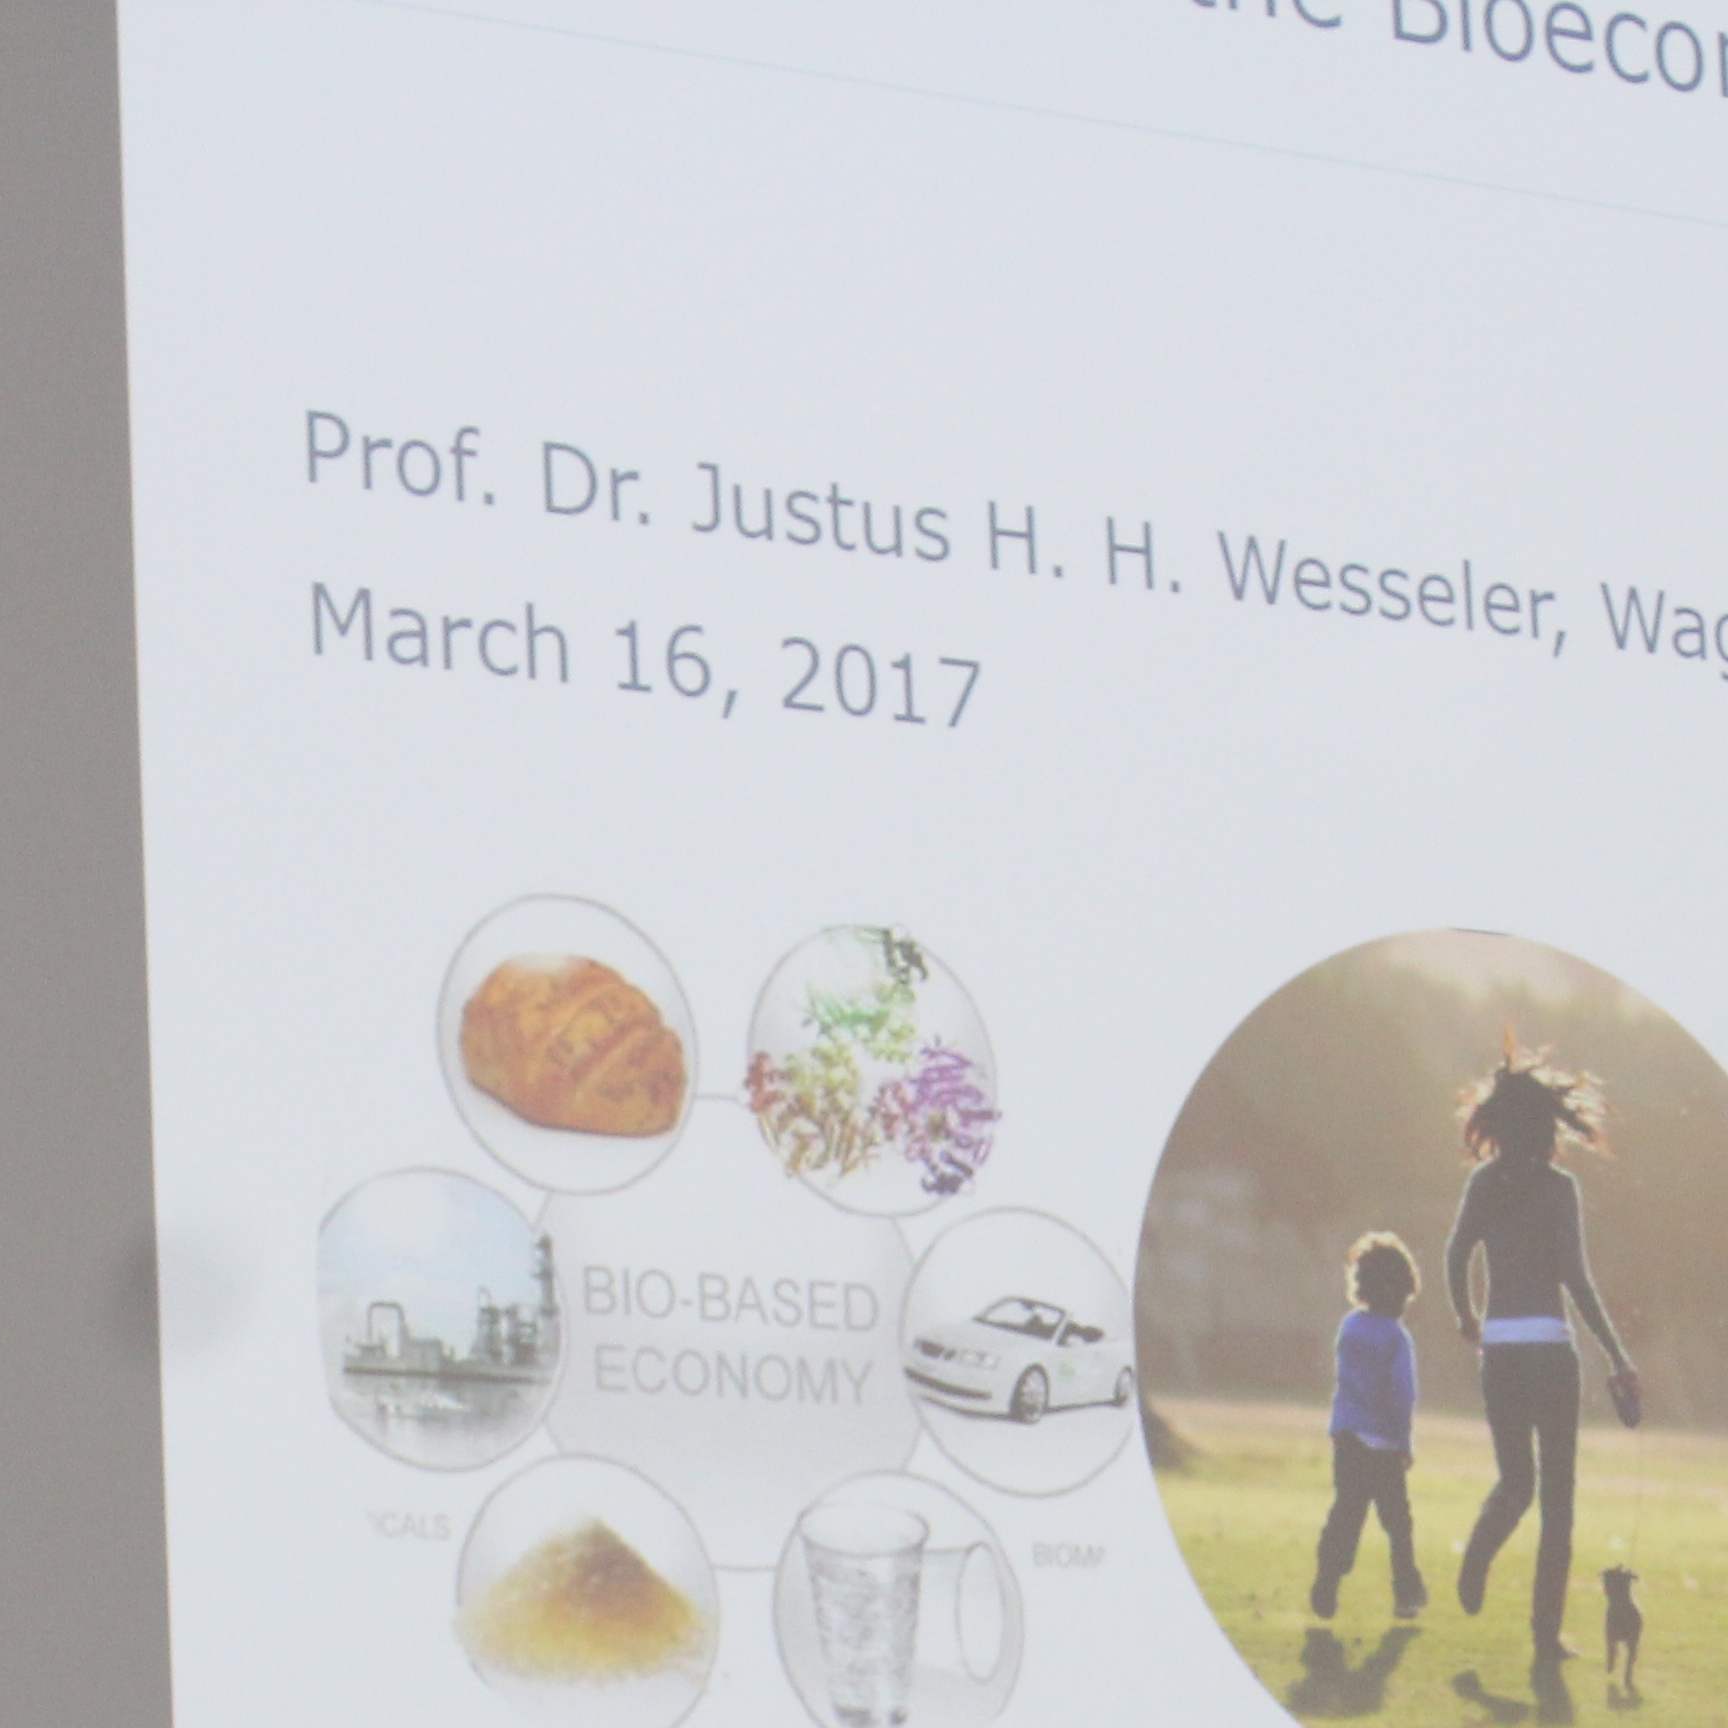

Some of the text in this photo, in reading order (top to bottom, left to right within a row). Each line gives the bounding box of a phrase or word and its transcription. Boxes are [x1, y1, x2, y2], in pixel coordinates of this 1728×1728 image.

[306, 409, 495, 506] Prof.
[543, 440, 650, 526] Dr.
[692, 462, 951, 563] Justus
[988, 500, 1064, 578] H.
[1106, 515, 1180, 593] H.
[1217, 529, 1566, 658] Wesseler,
[311, 580, 981, 729] March 16, 2017
[582, 1265, 879, 1332] BIO-BASED
[594, 1344, 872, 1405] ECONOMY
